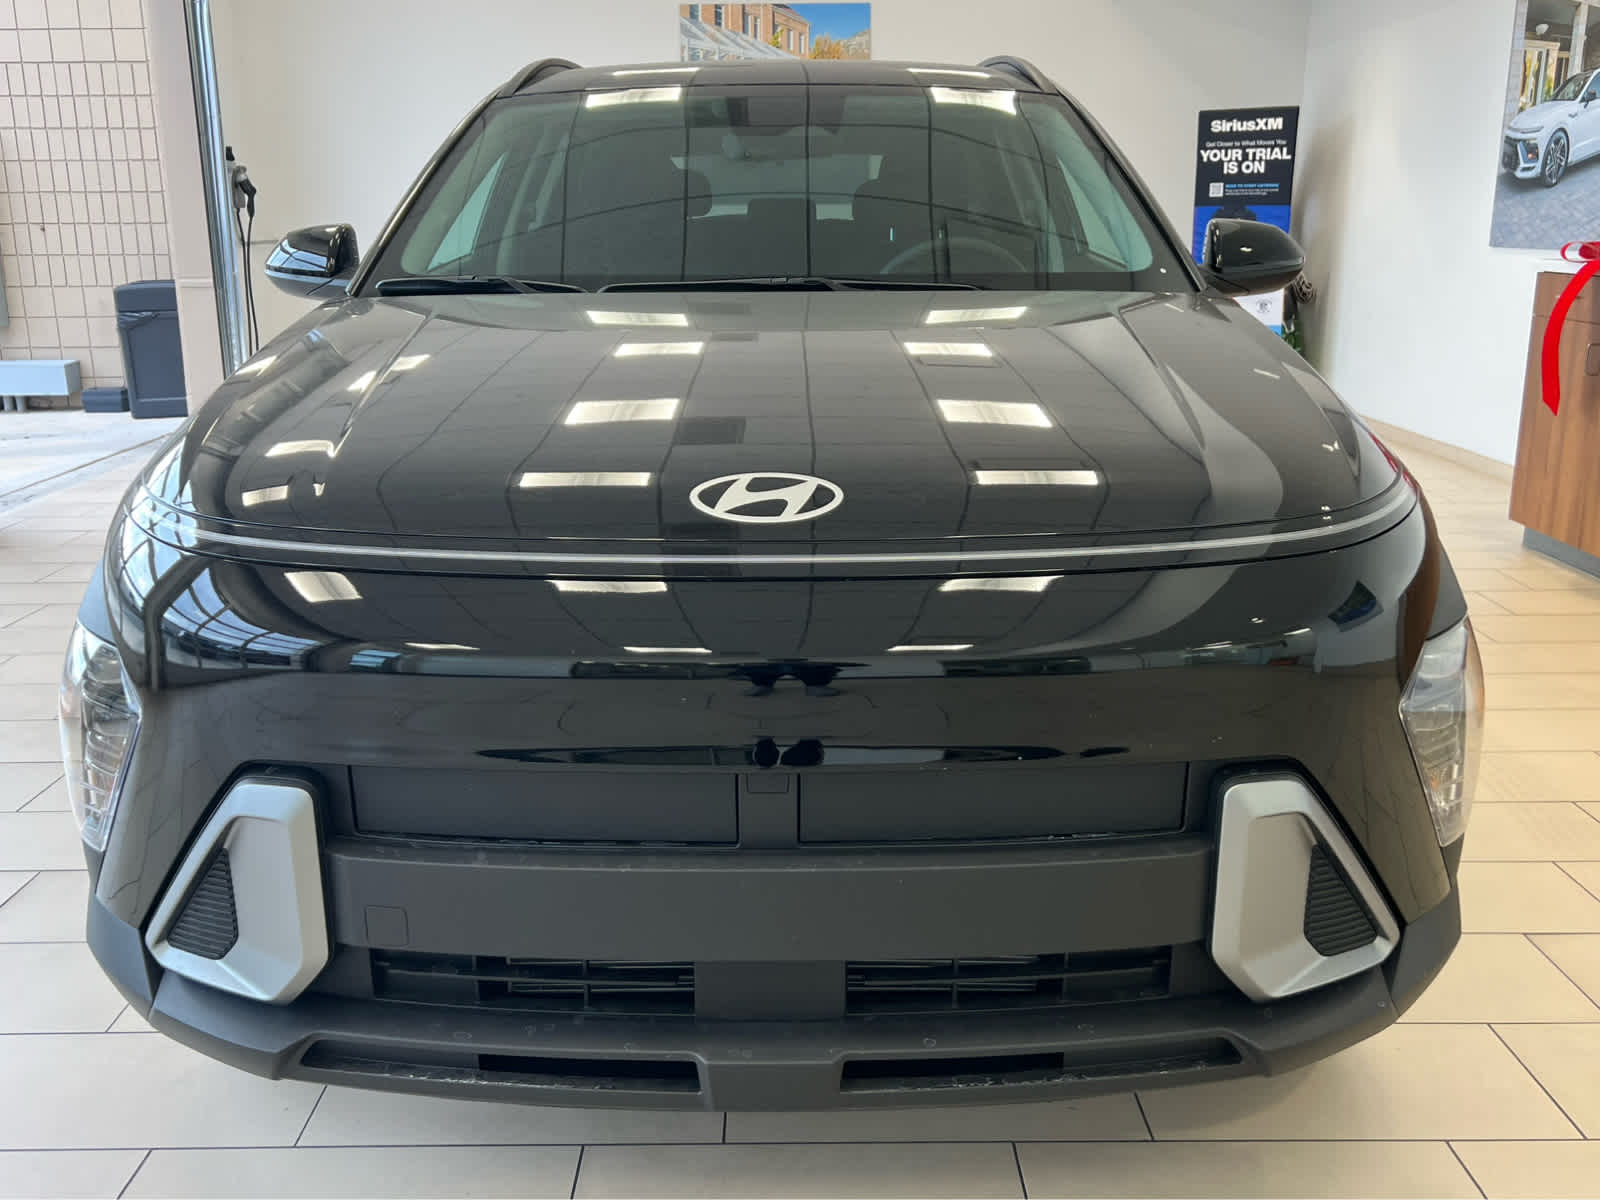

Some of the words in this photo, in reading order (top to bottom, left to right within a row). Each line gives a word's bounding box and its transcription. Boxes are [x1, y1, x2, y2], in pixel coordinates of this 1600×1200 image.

[1210, 117, 1284, 133] SiriusXM
[1200, 148, 1243, 162] YOUR
[1245, 147, 1292, 161] TRIAL
[1223, 161, 1239, 174] IS
[1241, 160, 1266, 174] ON
